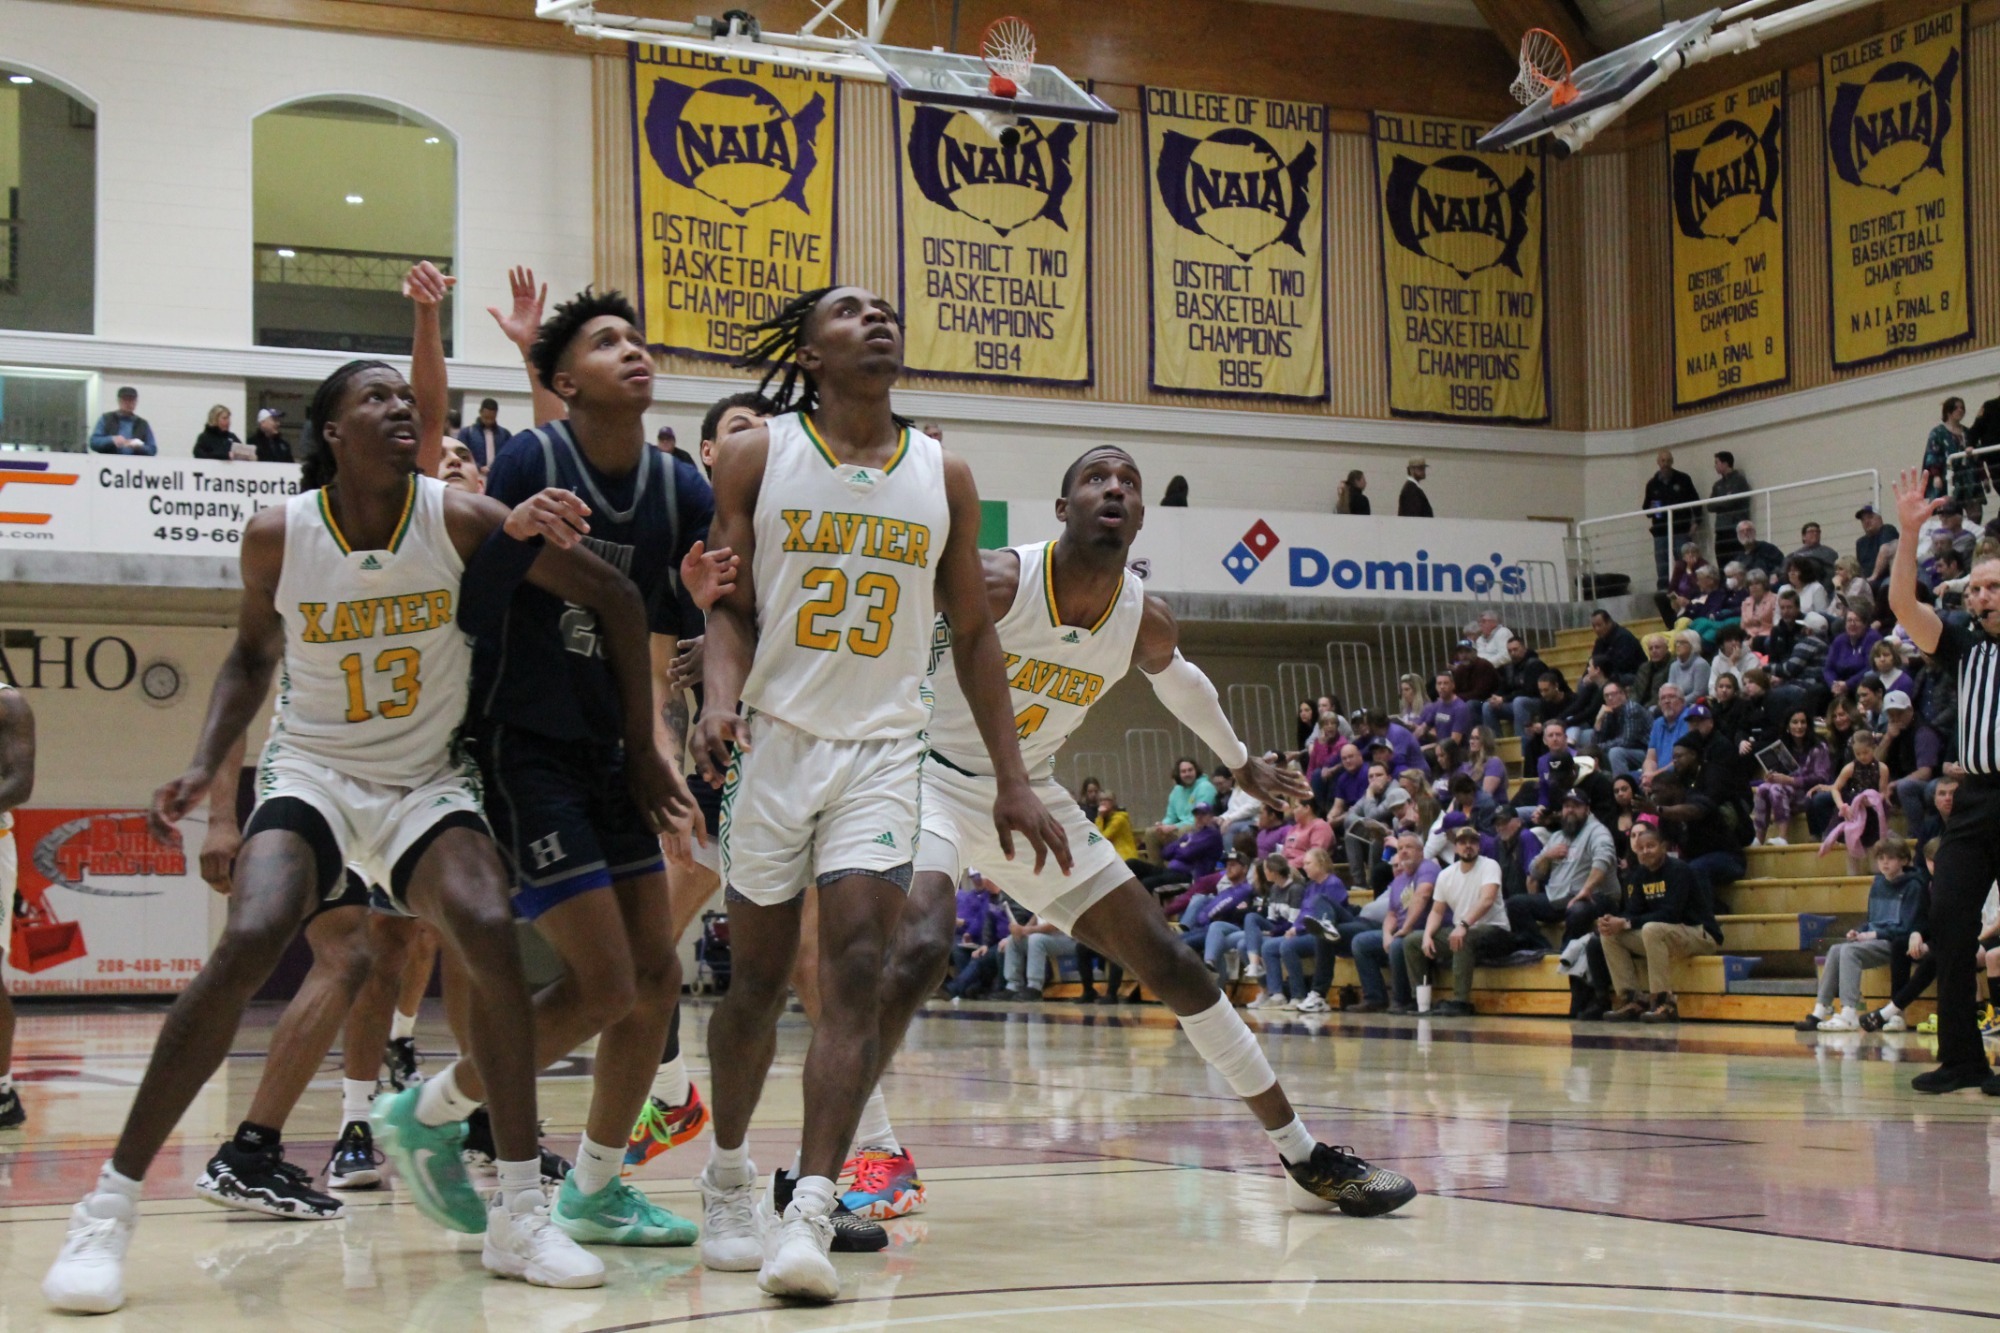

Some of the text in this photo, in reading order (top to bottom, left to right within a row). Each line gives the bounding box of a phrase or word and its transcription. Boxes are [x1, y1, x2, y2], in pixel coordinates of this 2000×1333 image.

[1830, 11, 1953, 74] COLLEGE OF IDAHO
[1147, 88, 1323, 133] COLLEGE OF IDAHO
[1670, 79, 1780, 133] COLLEGE OF IDAHO
[680, 118, 795, 179] NAIA
[1377, 115, 1457, 149] COLLEGE
[1855, 94, 1932, 170] NAIA
[943, 131, 1049, 193] NAIA
[1190, 159, 1292, 218] NAIA
[1691, 149, 1763, 220] NAIA
[1414, 183, 1505, 238] NAIA
[1850, 198, 1945, 244] DISTRICT TWO
[653, 212, 821, 262] DISTRICT FIVE
[1852, 223, 1944, 267] BASKETBALL
[662, 246, 808, 294] BASKETBALL
[923, 236, 1068, 278] DISTRICT TWO
[1688, 252, 1766, 291] DISTRICT TWO
[1865, 250, 1933, 286] CHAMPIONS
[926, 269, 1065, 310] BASKETBALL
[1173, 260, 1305, 297] DISTRICT TWO
[1693, 277, 1763, 312] BASKETBALL
[1175, 291, 1303, 328] BASKETBALL
[1400, 284, 1534, 319] DISTRICT TWO
[1700, 300, 1758, 332] CHAMPIONS
[1897, 294, 1935, 319] FINAL
[1940, 291, 1949, 311] 8
[707, 318, 758, 351] 1962
[938, 304, 1054, 340] CHAMPIONS
[1188, 323, 1292, 357] CHAMPIONS
[1406, 316, 1530, 350] BASKETBALL
[974, 340, 1022, 371] 1984
[1218, 358, 1262, 388] 1985
[1418, 349, 1520, 380] CHAMPIONS
[1687, 336, 1773, 376] NAIA FINAL 8
[1449, 384, 1493, 411] 1986
[100, 468, 184, 491] Caldwell
[150, 495, 244, 521] Company,
[154, 526, 244, 543] 459-66
[781, 509, 930, 568] XAVIER
[1289, 547, 1526, 595] Domino's
[300, 589, 452, 643] XAVIER
[796, 566, 900, 658] 23
[340, 646, 421, 723] 13
[528, 832, 567, 869] H
